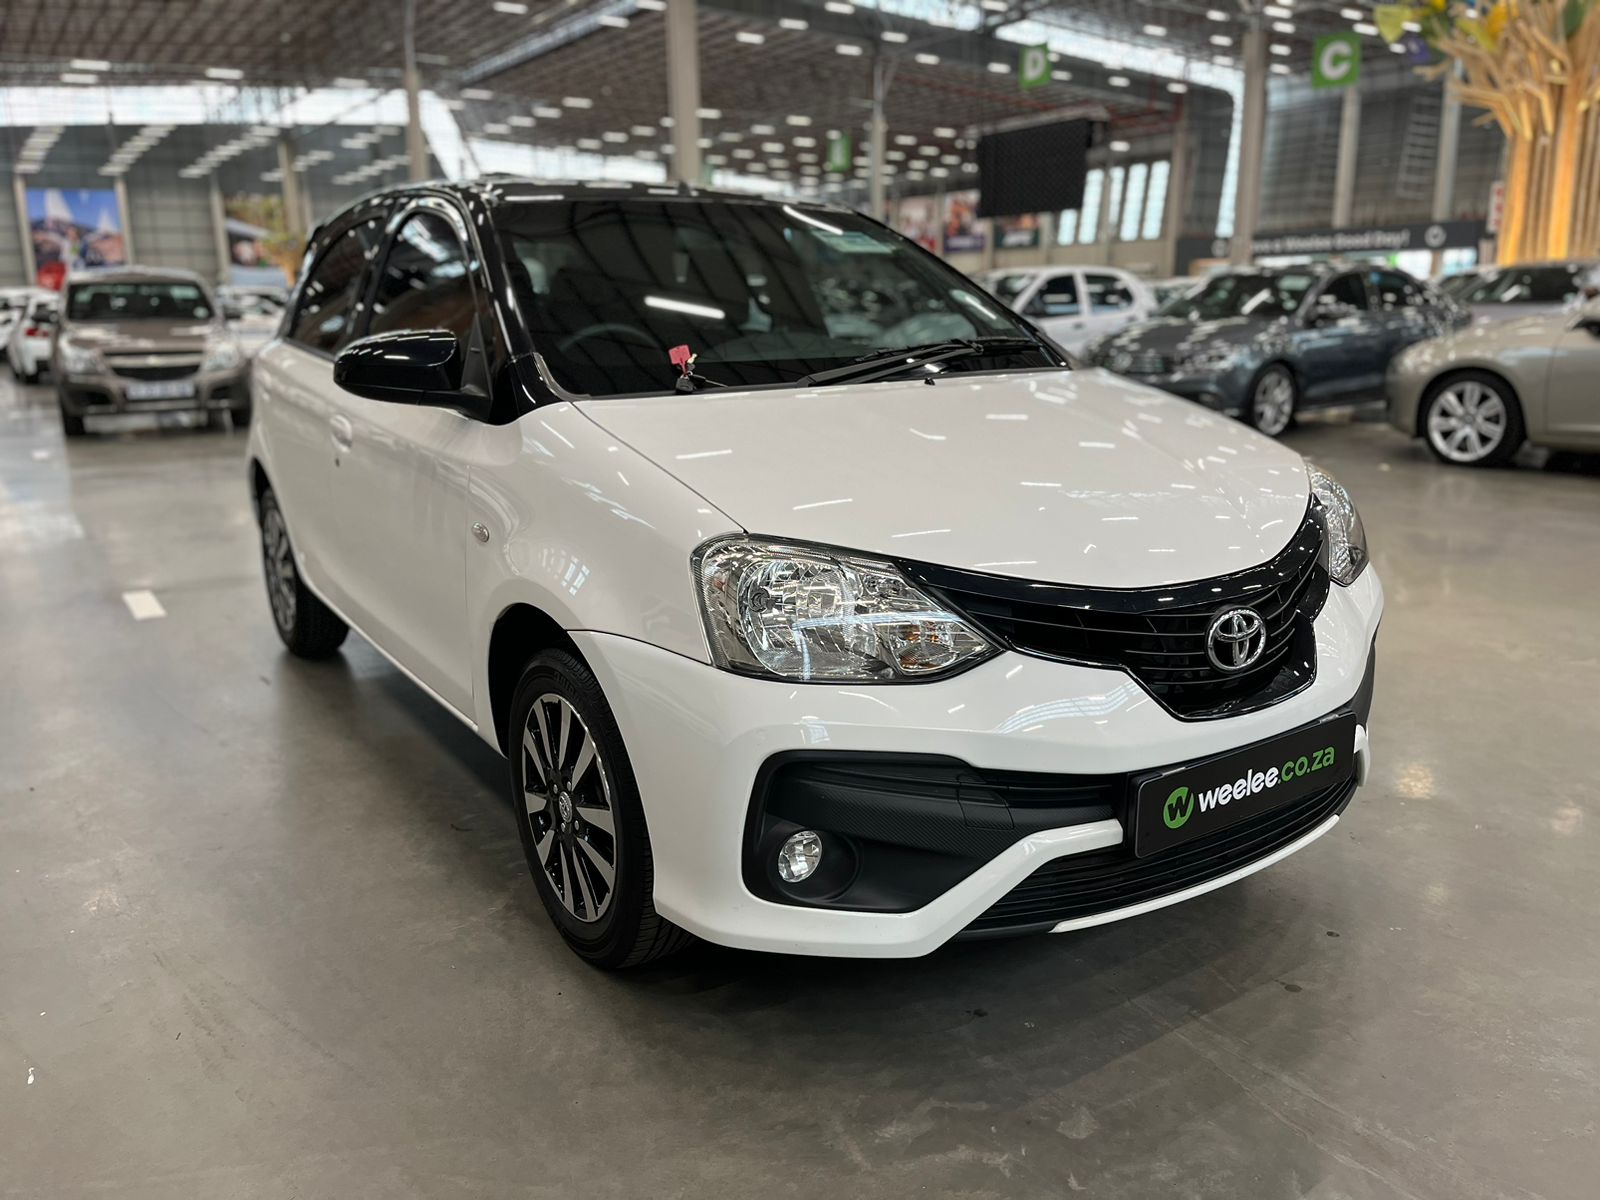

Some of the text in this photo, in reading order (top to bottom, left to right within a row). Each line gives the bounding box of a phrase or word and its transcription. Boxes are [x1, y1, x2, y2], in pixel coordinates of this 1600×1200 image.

[1024, 48, 1046, 80] D
[1319, 40, 1352, 80] C
[1198, 746, 1335, 812] weelee.co.za
